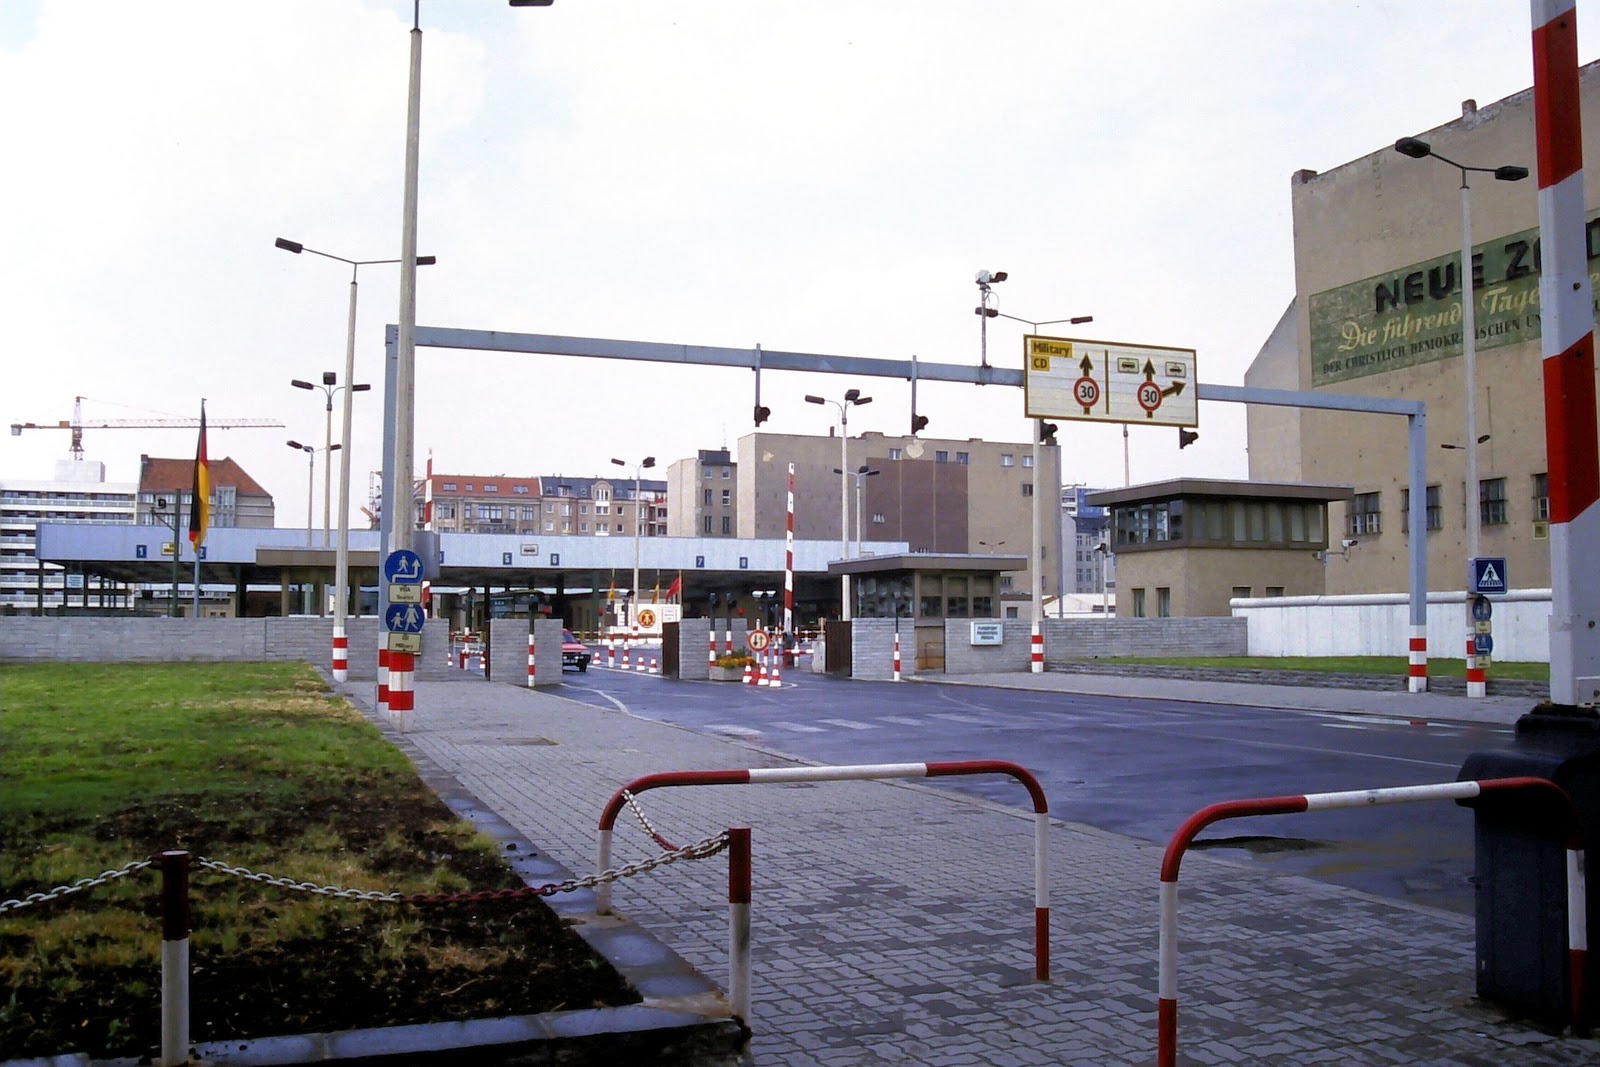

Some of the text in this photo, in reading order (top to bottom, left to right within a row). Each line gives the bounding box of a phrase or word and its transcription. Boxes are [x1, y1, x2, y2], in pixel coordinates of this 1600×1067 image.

[1376, 253, 1484, 313] NEUE
[1338, 320, 1377, 352] Die
[1033, 342, 1070, 358] Military
[1033, 358, 1047, 368] CD
[1322, 360, 1342, 375] DER
[1345, 346, 1405, 369] CHRISTLICH
[1080, 385, 1095, 399] 30
[1143, 389, 1158, 403] 30
